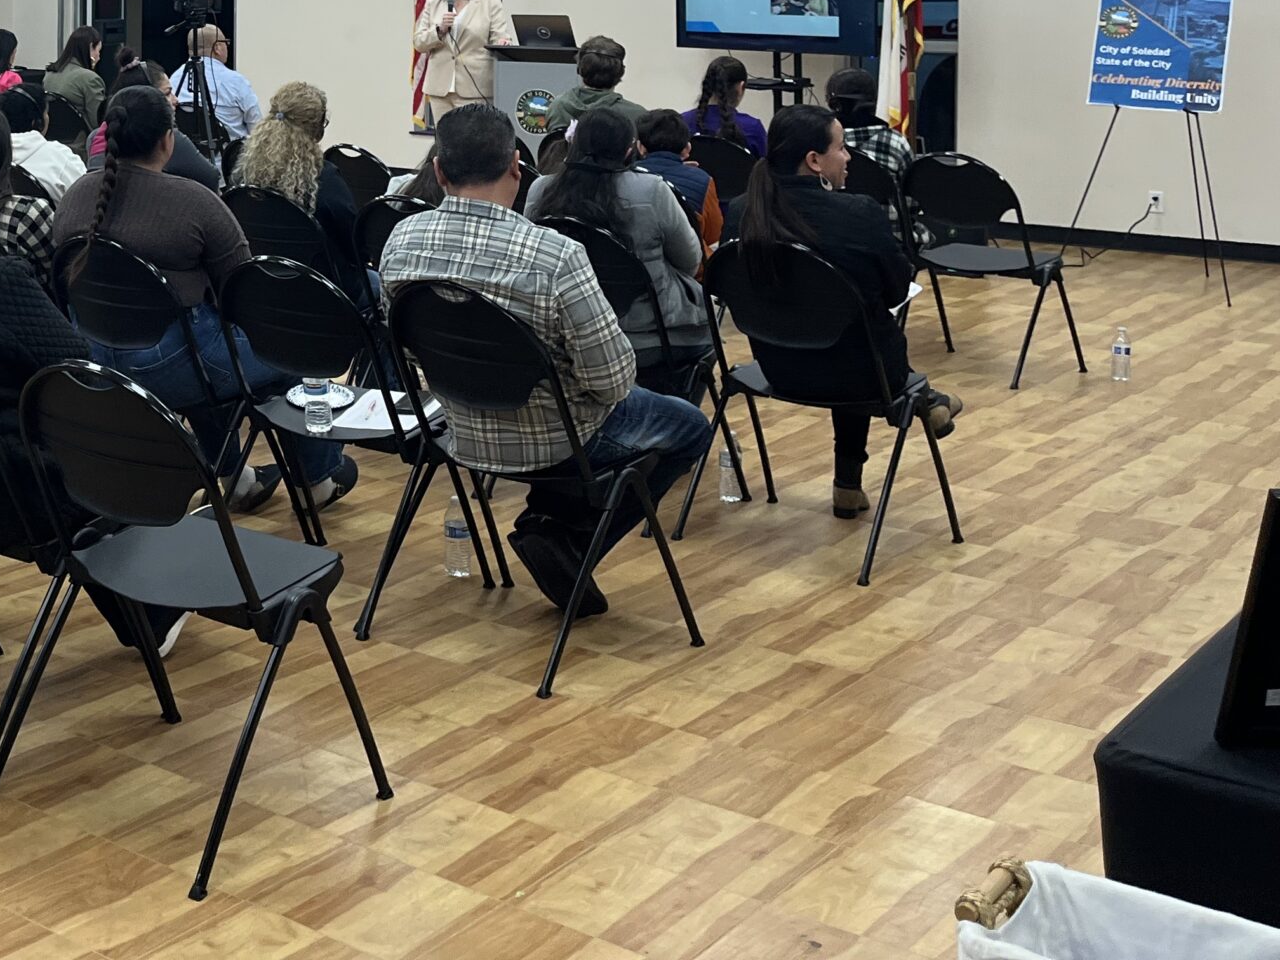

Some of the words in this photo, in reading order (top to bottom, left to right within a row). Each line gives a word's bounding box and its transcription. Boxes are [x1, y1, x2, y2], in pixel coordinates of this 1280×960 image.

[1099, 45, 1119, 55] City
[1120, 46, 1131, 54] of
[1131, 46, 1171, 57] Soledad
[1095, 56, 1120, 66] State
[1122, 58, 1133, 66] of
[1134, 59, 1150, 67] the
[1151, 60, 1172, 70] City
[1092, 73, 1164, 88] Celebrating
[1165, 77, 1222, 92] Diversity
[1130, 89, 1184, 104] Building
[1185, 92, 1220, 107] Unity
